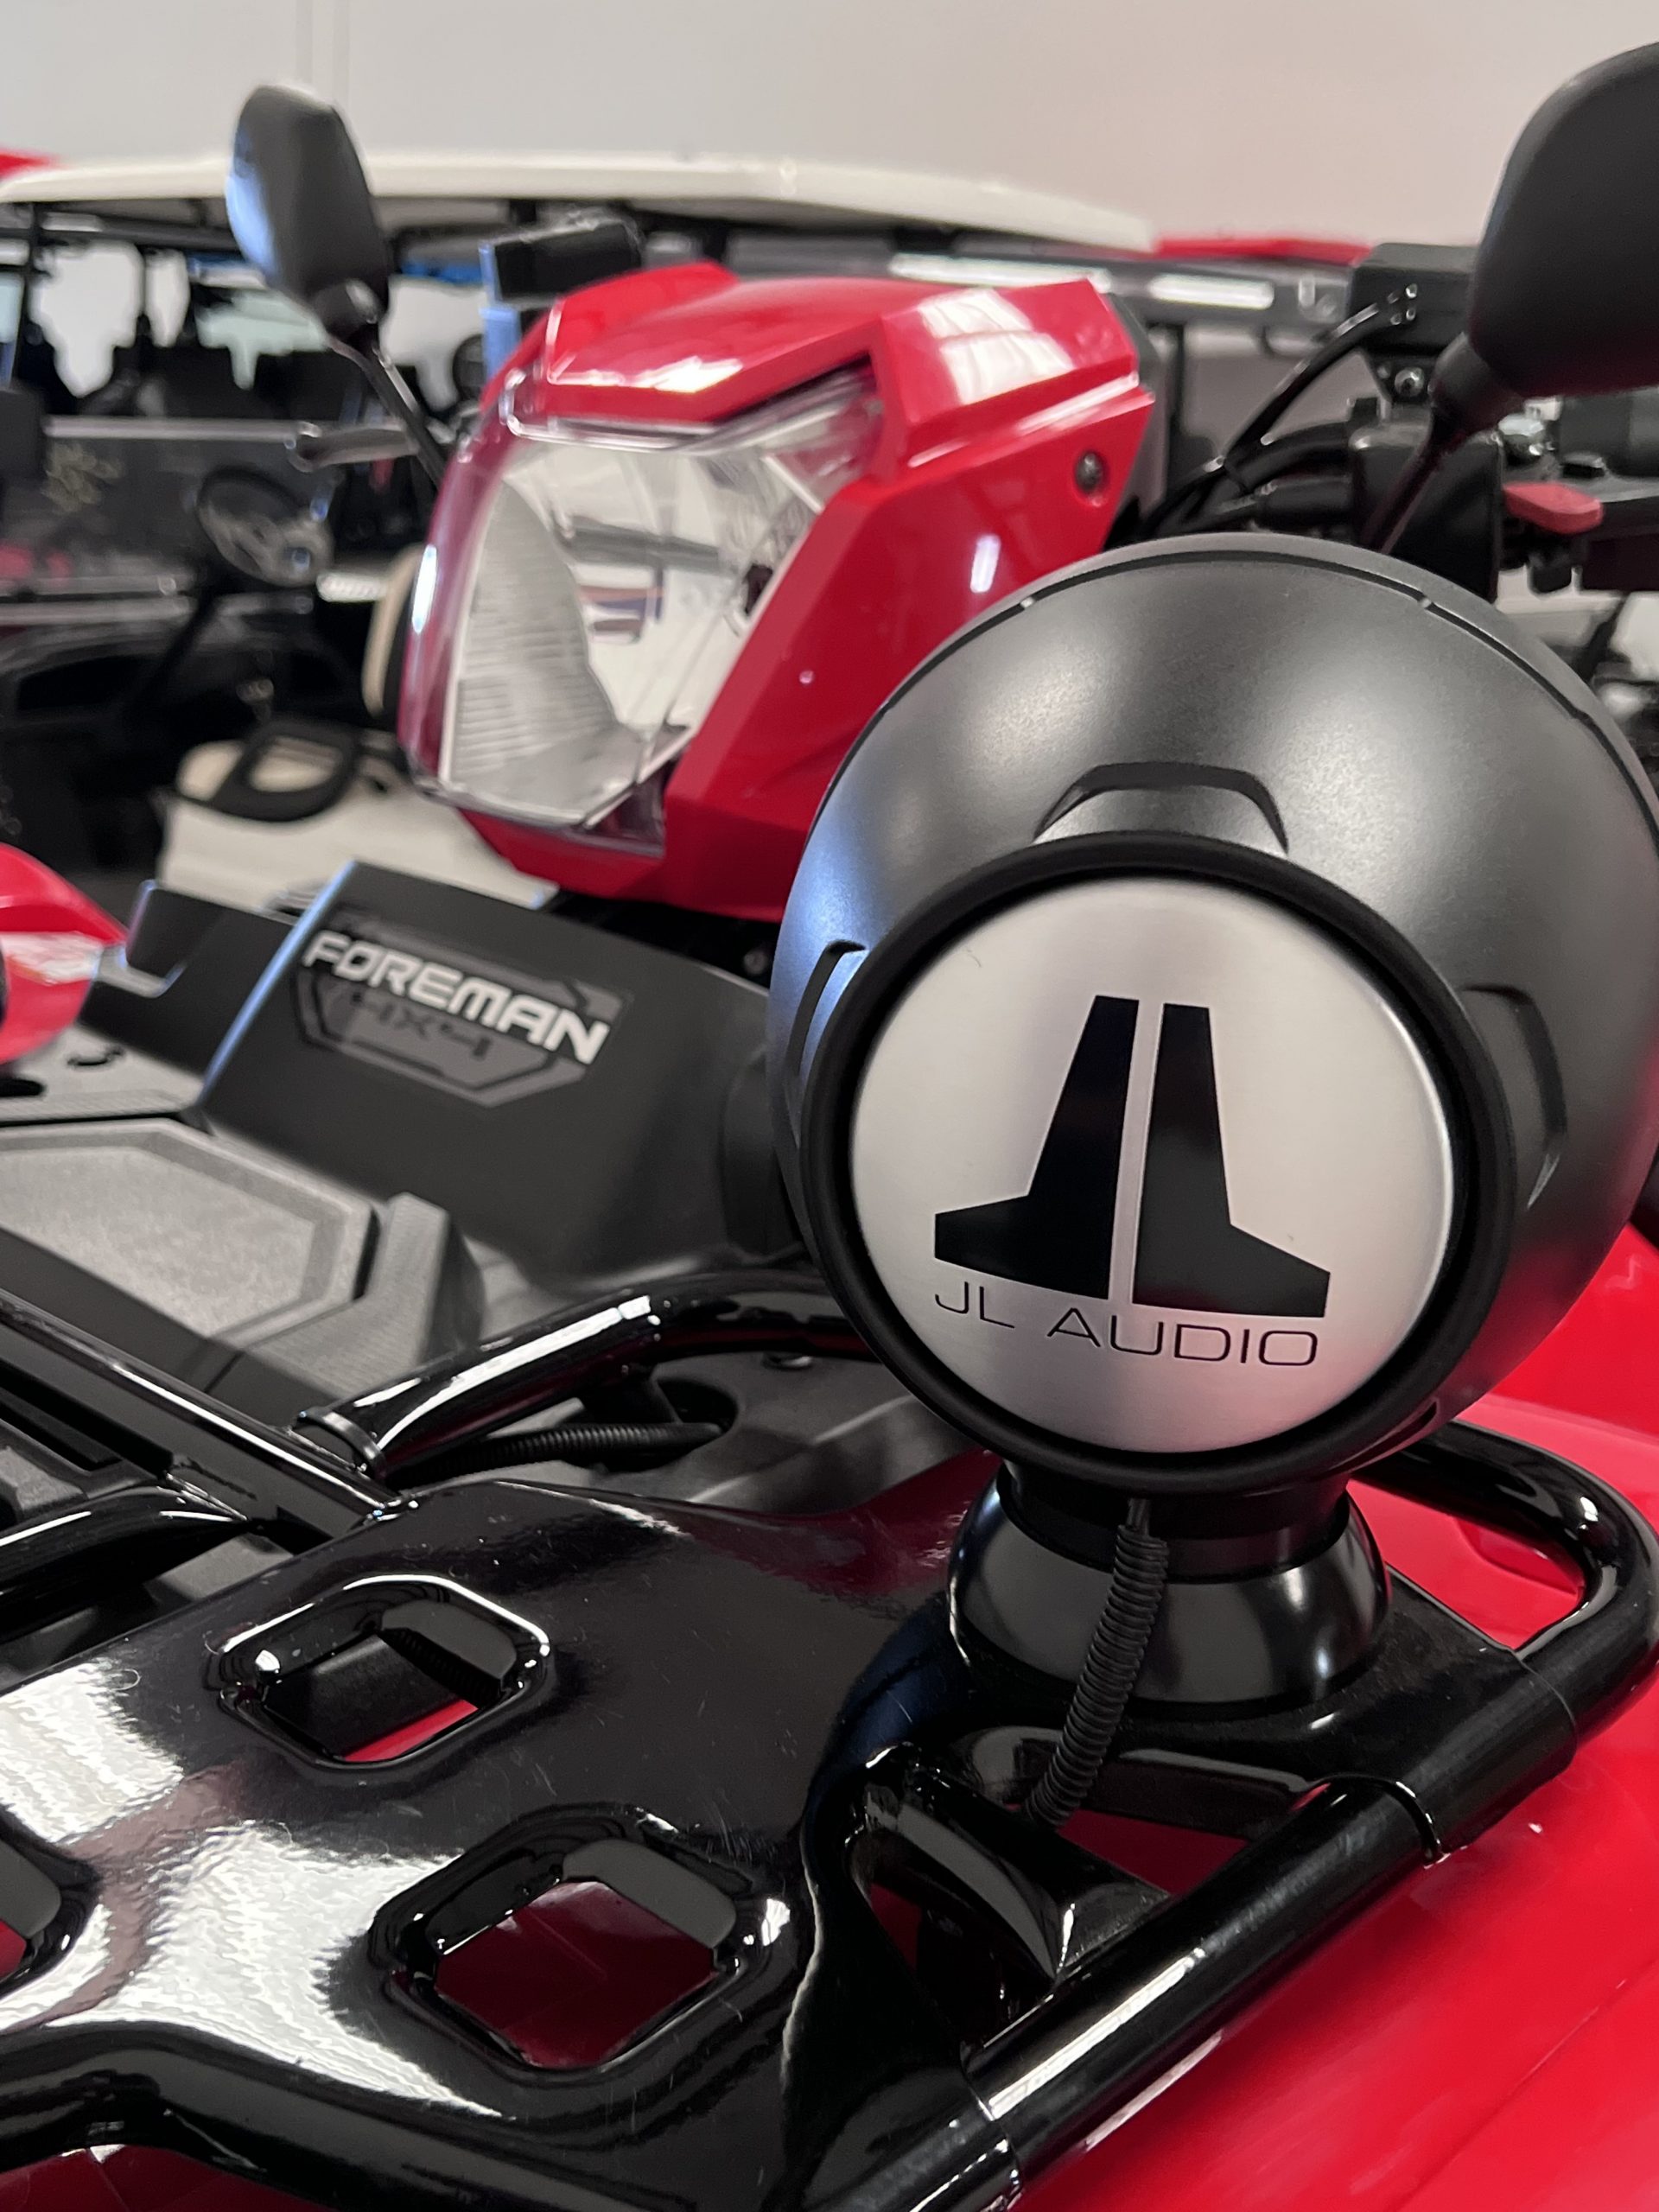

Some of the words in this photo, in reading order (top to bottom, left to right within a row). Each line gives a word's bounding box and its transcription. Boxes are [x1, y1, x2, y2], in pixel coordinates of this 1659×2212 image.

[302, 930, 610, 1065] FOREMAN
[934, 1281, 1015, 1329] JL
[1046, 1307, 1319, 1366] AUDIO
